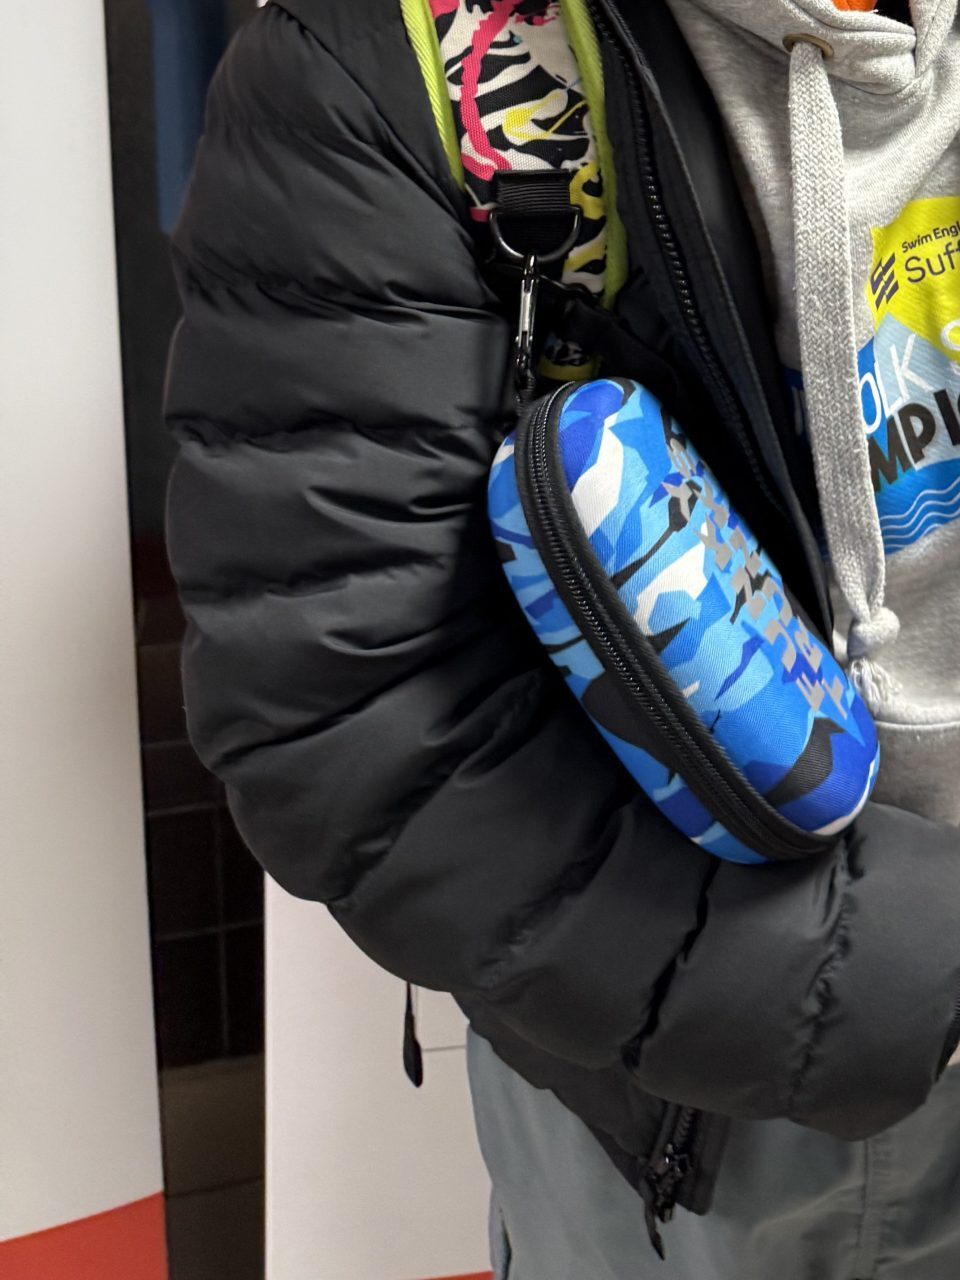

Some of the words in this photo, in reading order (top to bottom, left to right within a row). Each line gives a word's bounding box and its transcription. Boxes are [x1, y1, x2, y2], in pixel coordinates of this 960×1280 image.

[901, 232, 934, 253] Swim
[660, 481, 827, 712] FUNKY
[668, 437, 849, 721] TRUNKS
